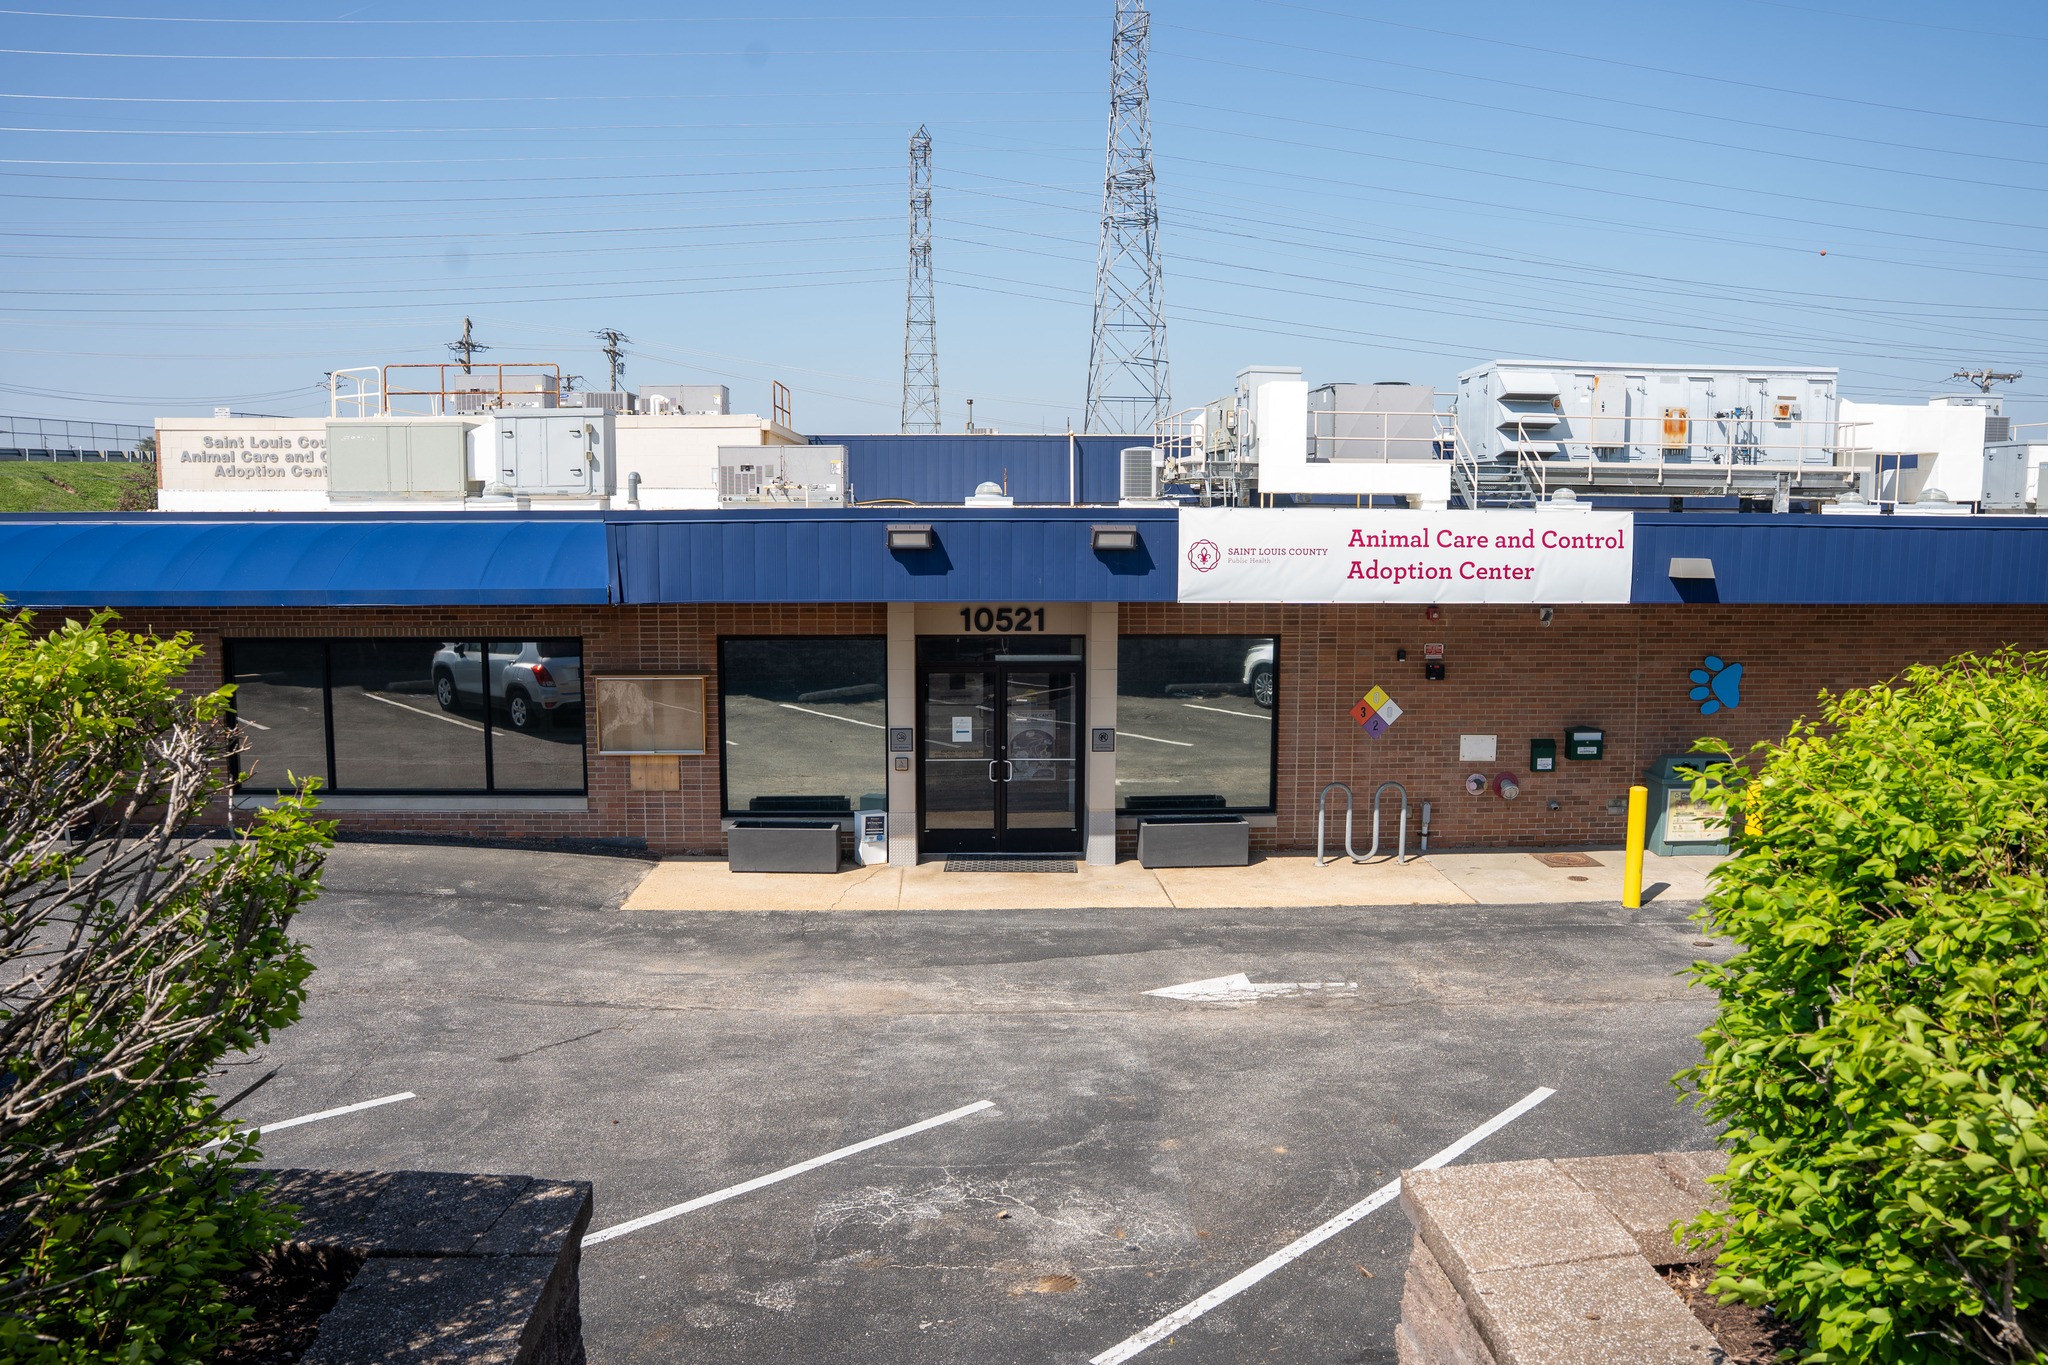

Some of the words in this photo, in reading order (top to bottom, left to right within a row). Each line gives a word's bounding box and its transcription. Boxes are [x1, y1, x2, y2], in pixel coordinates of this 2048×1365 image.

[203, 436, 244, 449] Saint
[250, 436, 292, 449] Louis
[180, 450, 235, 463] Animal
[241, 450, 279, 463] Care
[285, 450, 314, 463] and
[214, 464, 286, 479] Adoption
[1347, 528, 1429, 549] Animal
[1436, 529, 1490, 549] Care
[1494, 529, 1535, 549] and
[1541, 530, 1626, 550] Control
[1227, 548, 1257, 556] SAINT
[1258, 548, 1287, 556] LOUIS
[1288, 548, 1329, 556] COUNTY
[1346, 560, 1453, 584] Adoption
[1458, 561, 1535, 581] Center
[960, 607, 1045, 632] 10521
[1360, 707, 1366, 718] 3
[1373, 720, 1379, 731] 2
